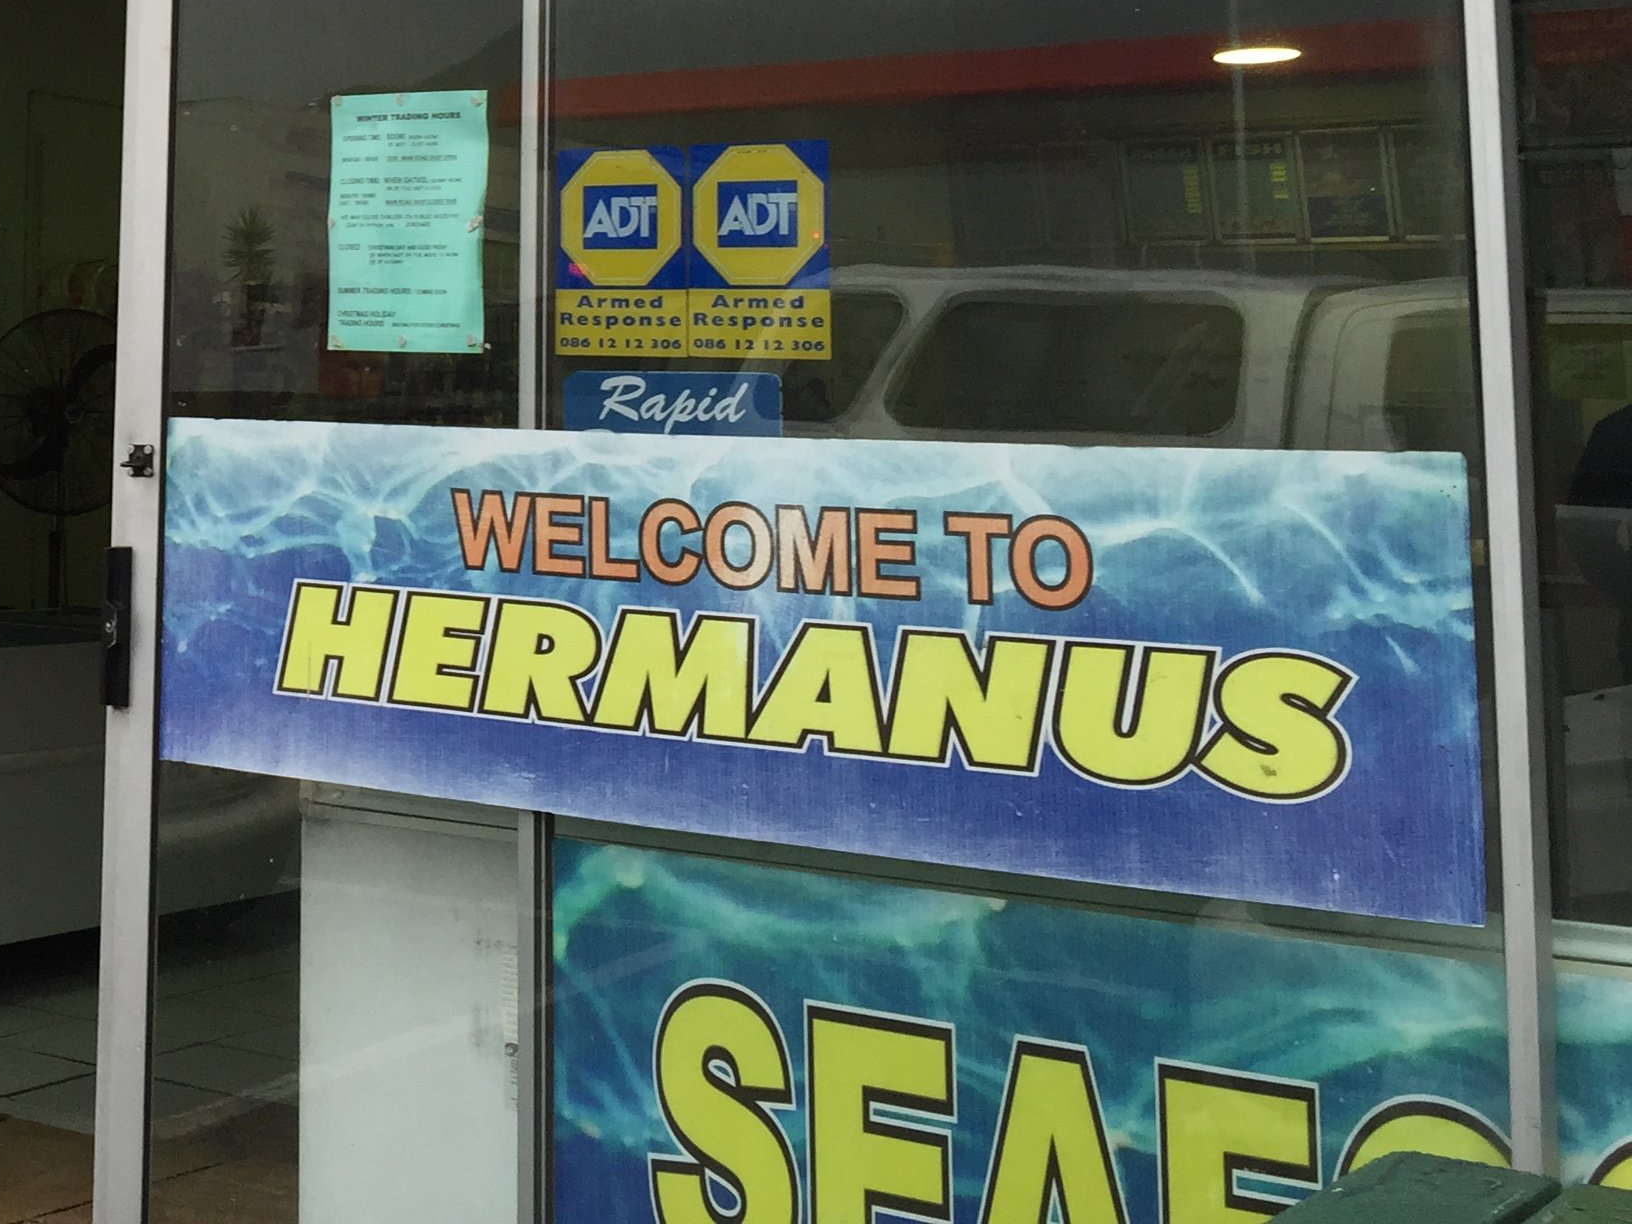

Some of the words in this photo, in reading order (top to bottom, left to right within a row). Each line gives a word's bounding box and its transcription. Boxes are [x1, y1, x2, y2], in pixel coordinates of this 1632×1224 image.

[390, 113, 429, 122] TRADING
[431, 112, 462, 120] HOURS
[584, 196, 658, 238] ADT
[718, 193, 798, 235] ADT
[577, 295, 663, 309] Armed
[711, 295, 805, 309] Armed
[560, 312, 682, 330] Response
[693, 312, 825, 330] Response
[560, 338, 590, 348] 086
[599, 338, 616, 348] 12
[625, 338, 643, 349] 12
[651, 339, 682, 350] 306
[693, 338, 726, 349] 086
[735, 339, 754, 350] 12
[764, 340, 784, 351] 12
[791, 340, 825, 352] 306
[599, 375, 749, 434] Rapid
[450, 488, 921, 601] WELCOME
[943, 510, 1093, 612] TO
[272, 578, 1359, 805] HERMANUS
